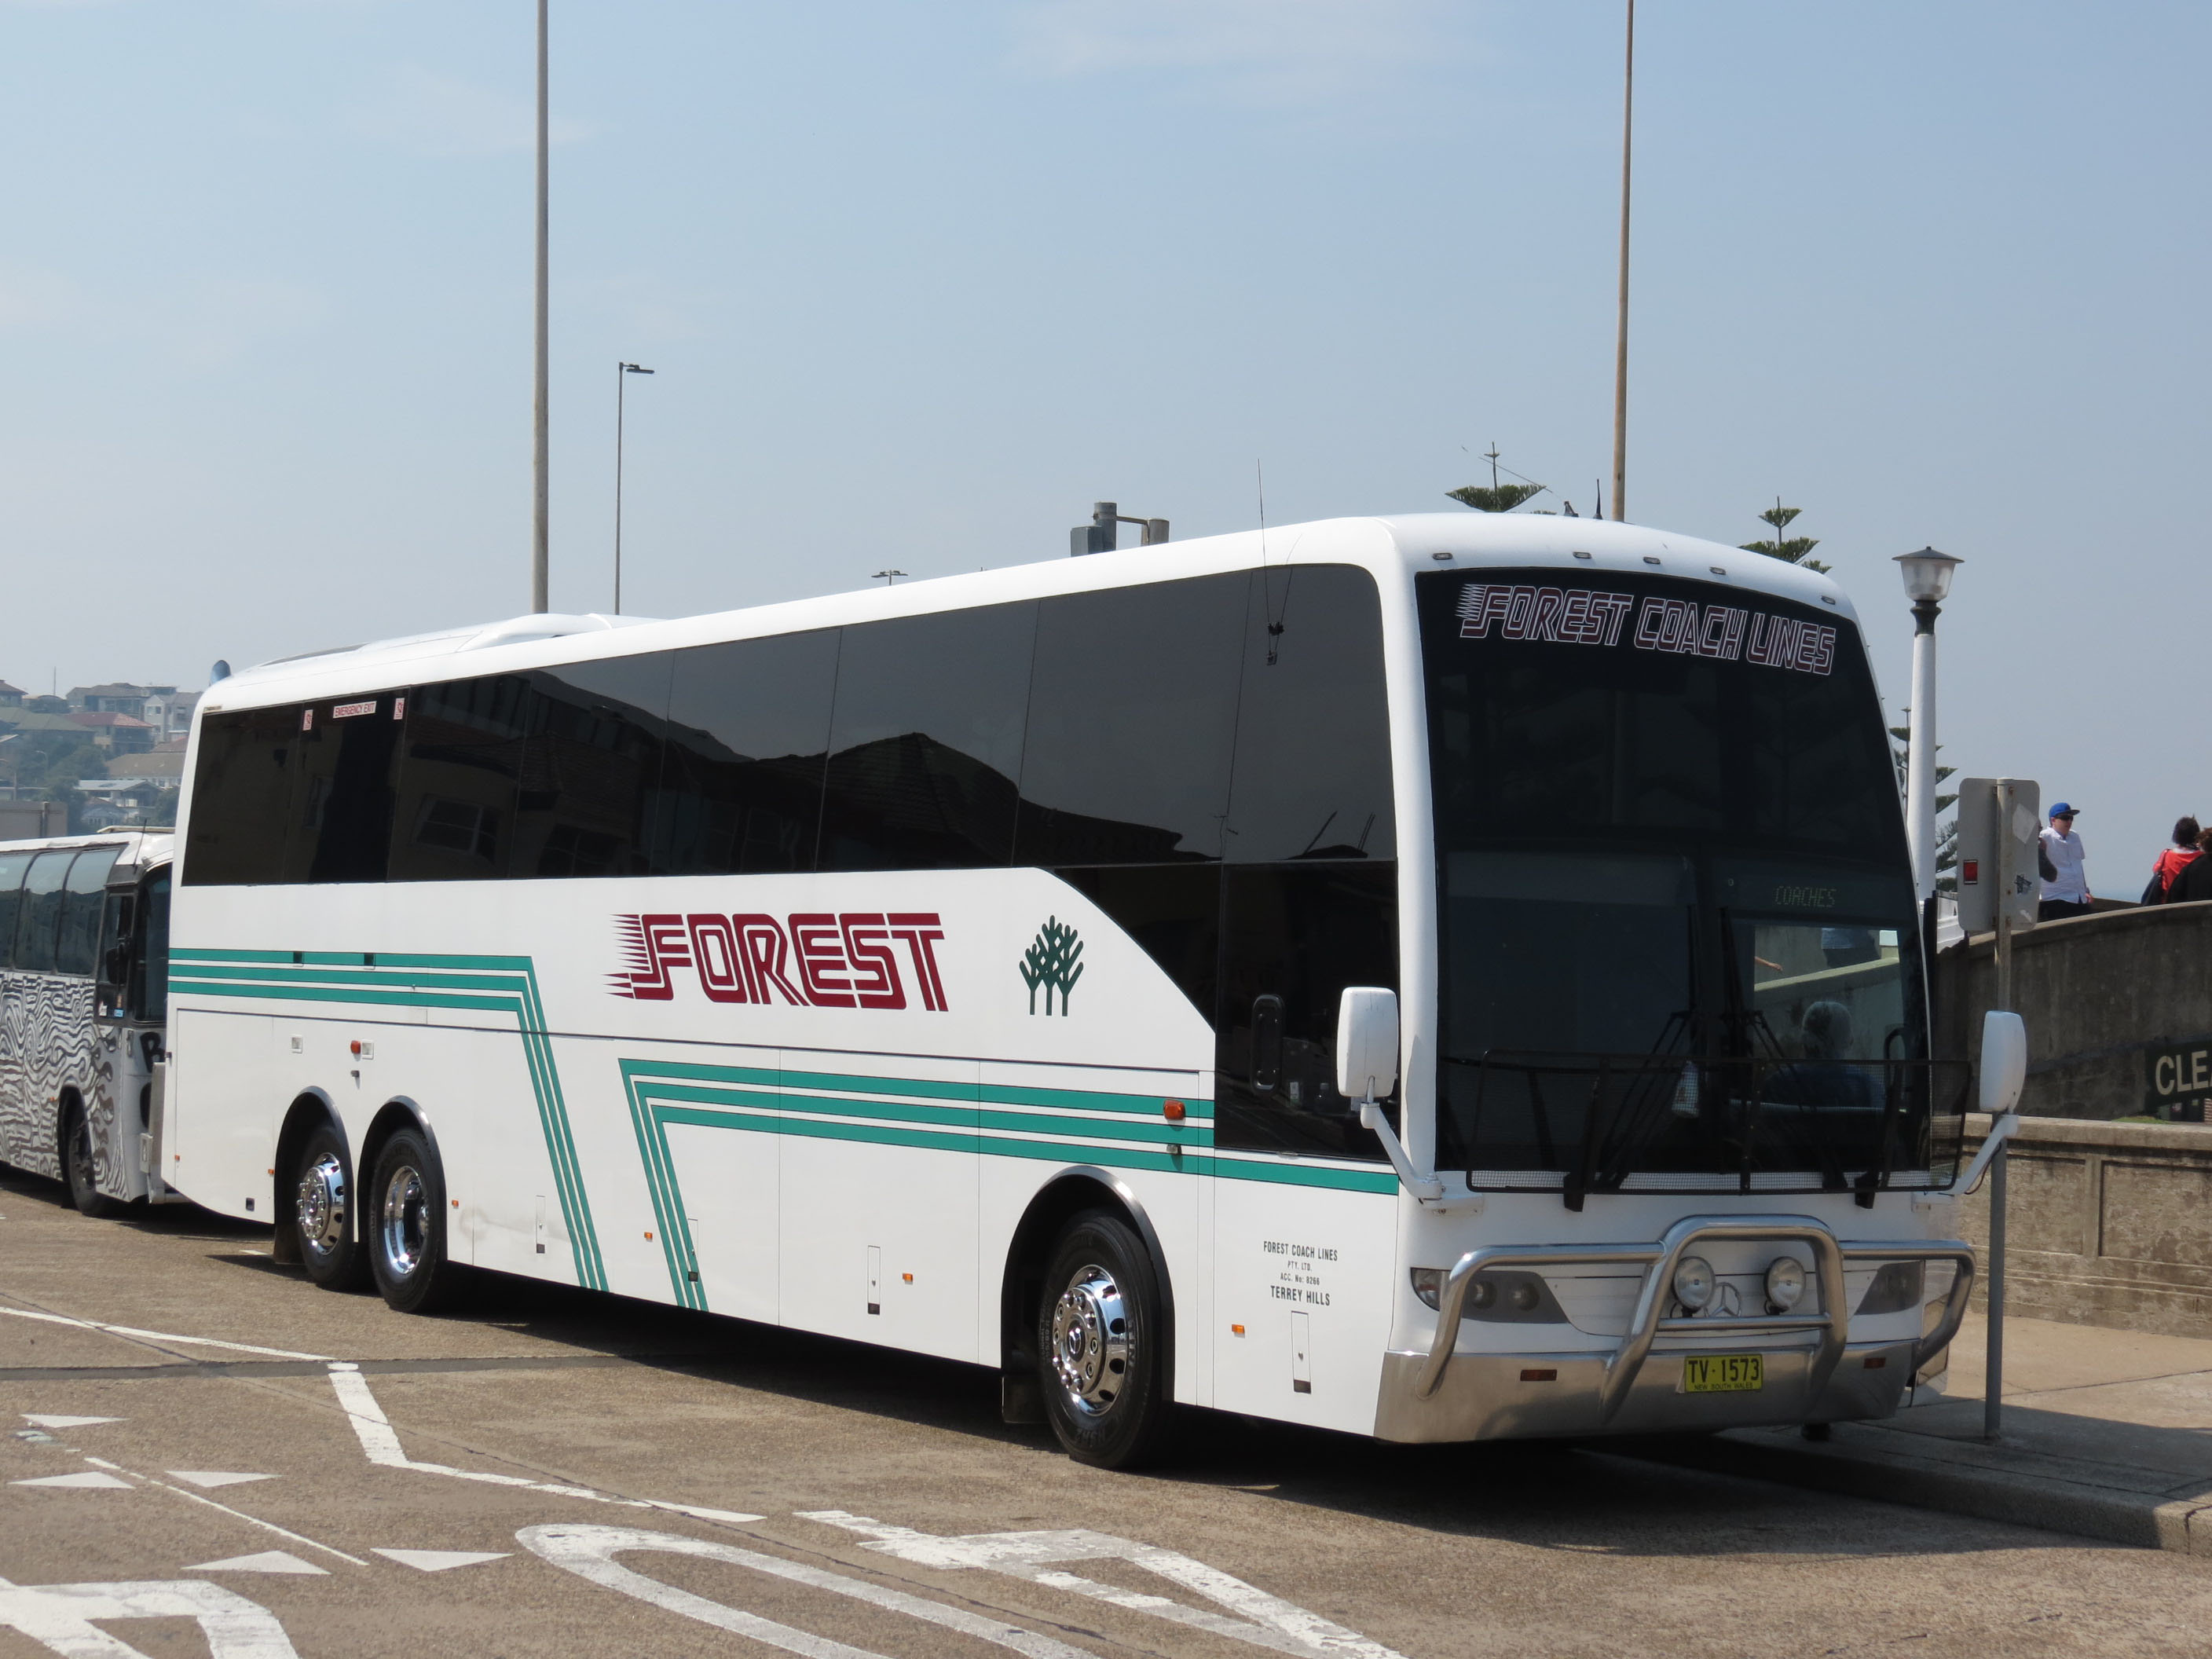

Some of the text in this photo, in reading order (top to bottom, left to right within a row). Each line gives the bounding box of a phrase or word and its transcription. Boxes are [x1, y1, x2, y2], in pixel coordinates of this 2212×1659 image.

[1455, 584, 1837, 676] FOREST COACH LINES
[364, 702, 375, 713] EXIT
[1774, 885, 1837, 908] COACHES
[600, 913, 949, 1012] FOREST
[2155, 1050, 2212, 1095] CLE
[1263, 1241, 1338, 1262] FOREST COACH LINES
[1287, 1260, 1313, 1272] PTY. LTD.
[1280, 1272, 1294, 1282] ACC.
[1270, 1285, 1331, 1306] TERREY HILLS
